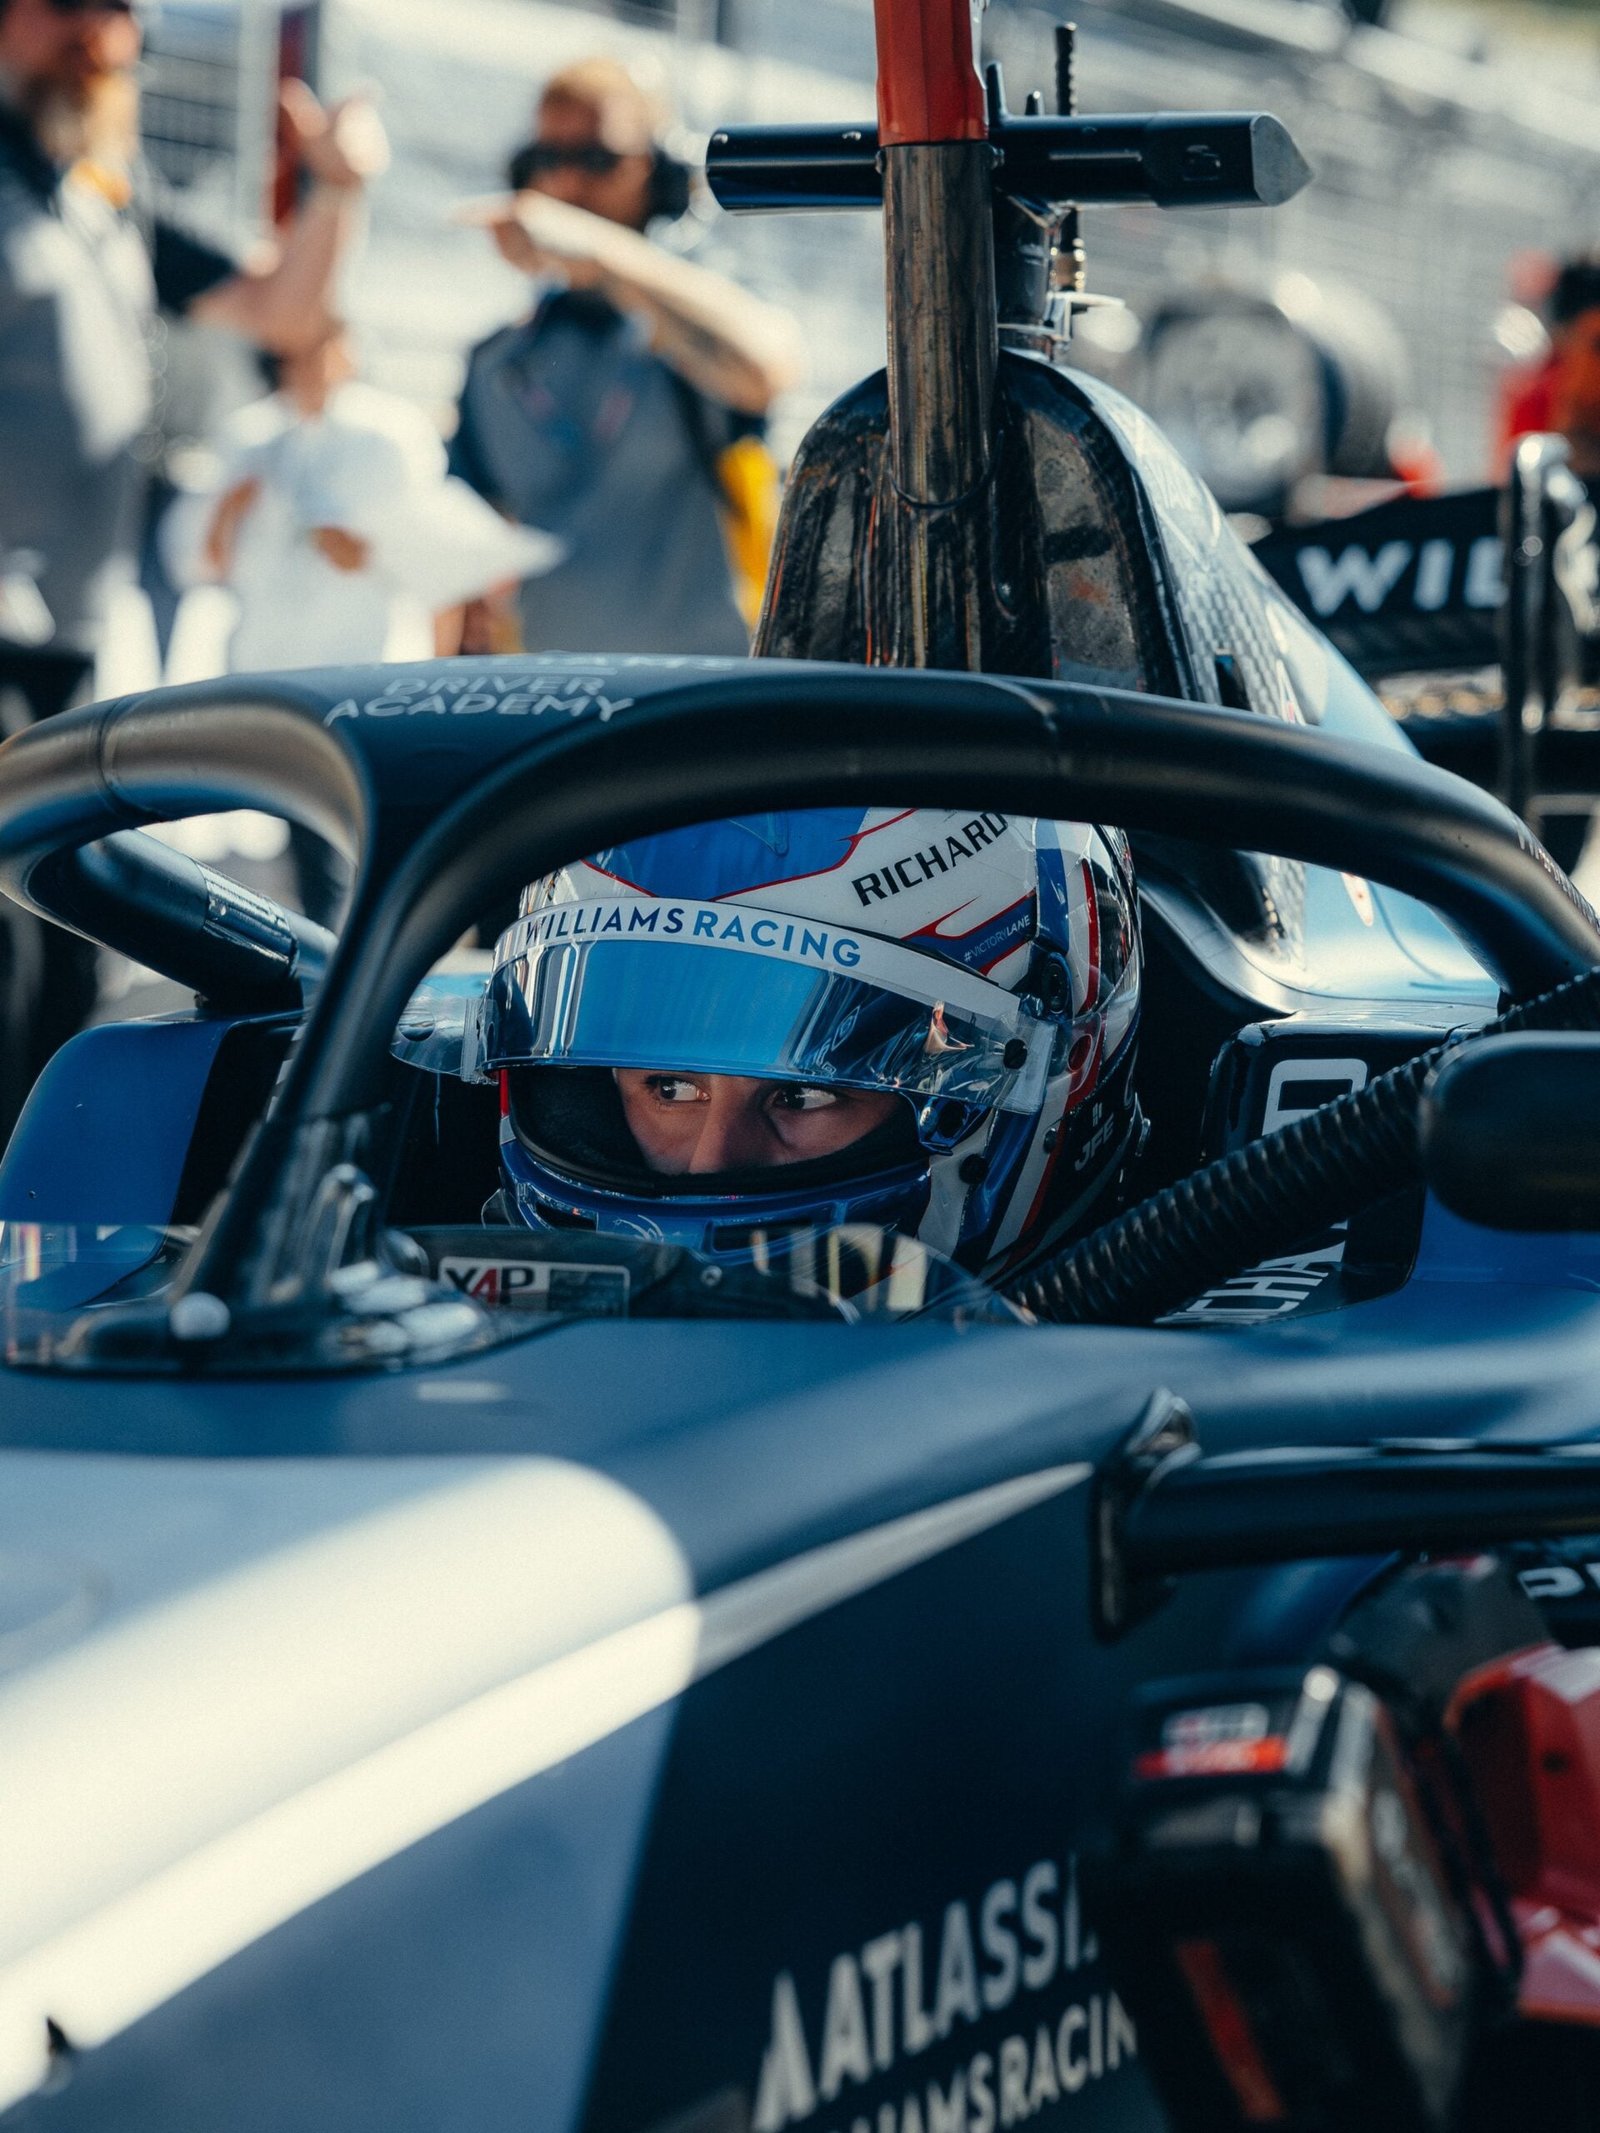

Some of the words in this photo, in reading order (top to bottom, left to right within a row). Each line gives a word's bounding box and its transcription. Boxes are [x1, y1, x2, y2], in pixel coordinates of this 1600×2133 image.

[322, 693, 636, 727] ACADEMY
[383, 676, 605, 697] DRIVER
[851, 812, 1008, 906] RICHARD
[526, 906, 685, 944] WILLIAMS
[693, 910, 861, 967] RACING
[964, 914, 1031, 962] #VICTORYLANE
[1074, 1112, 1114, 1171] JFE
[820, 1851, 1097, 2102] ATLASSI
